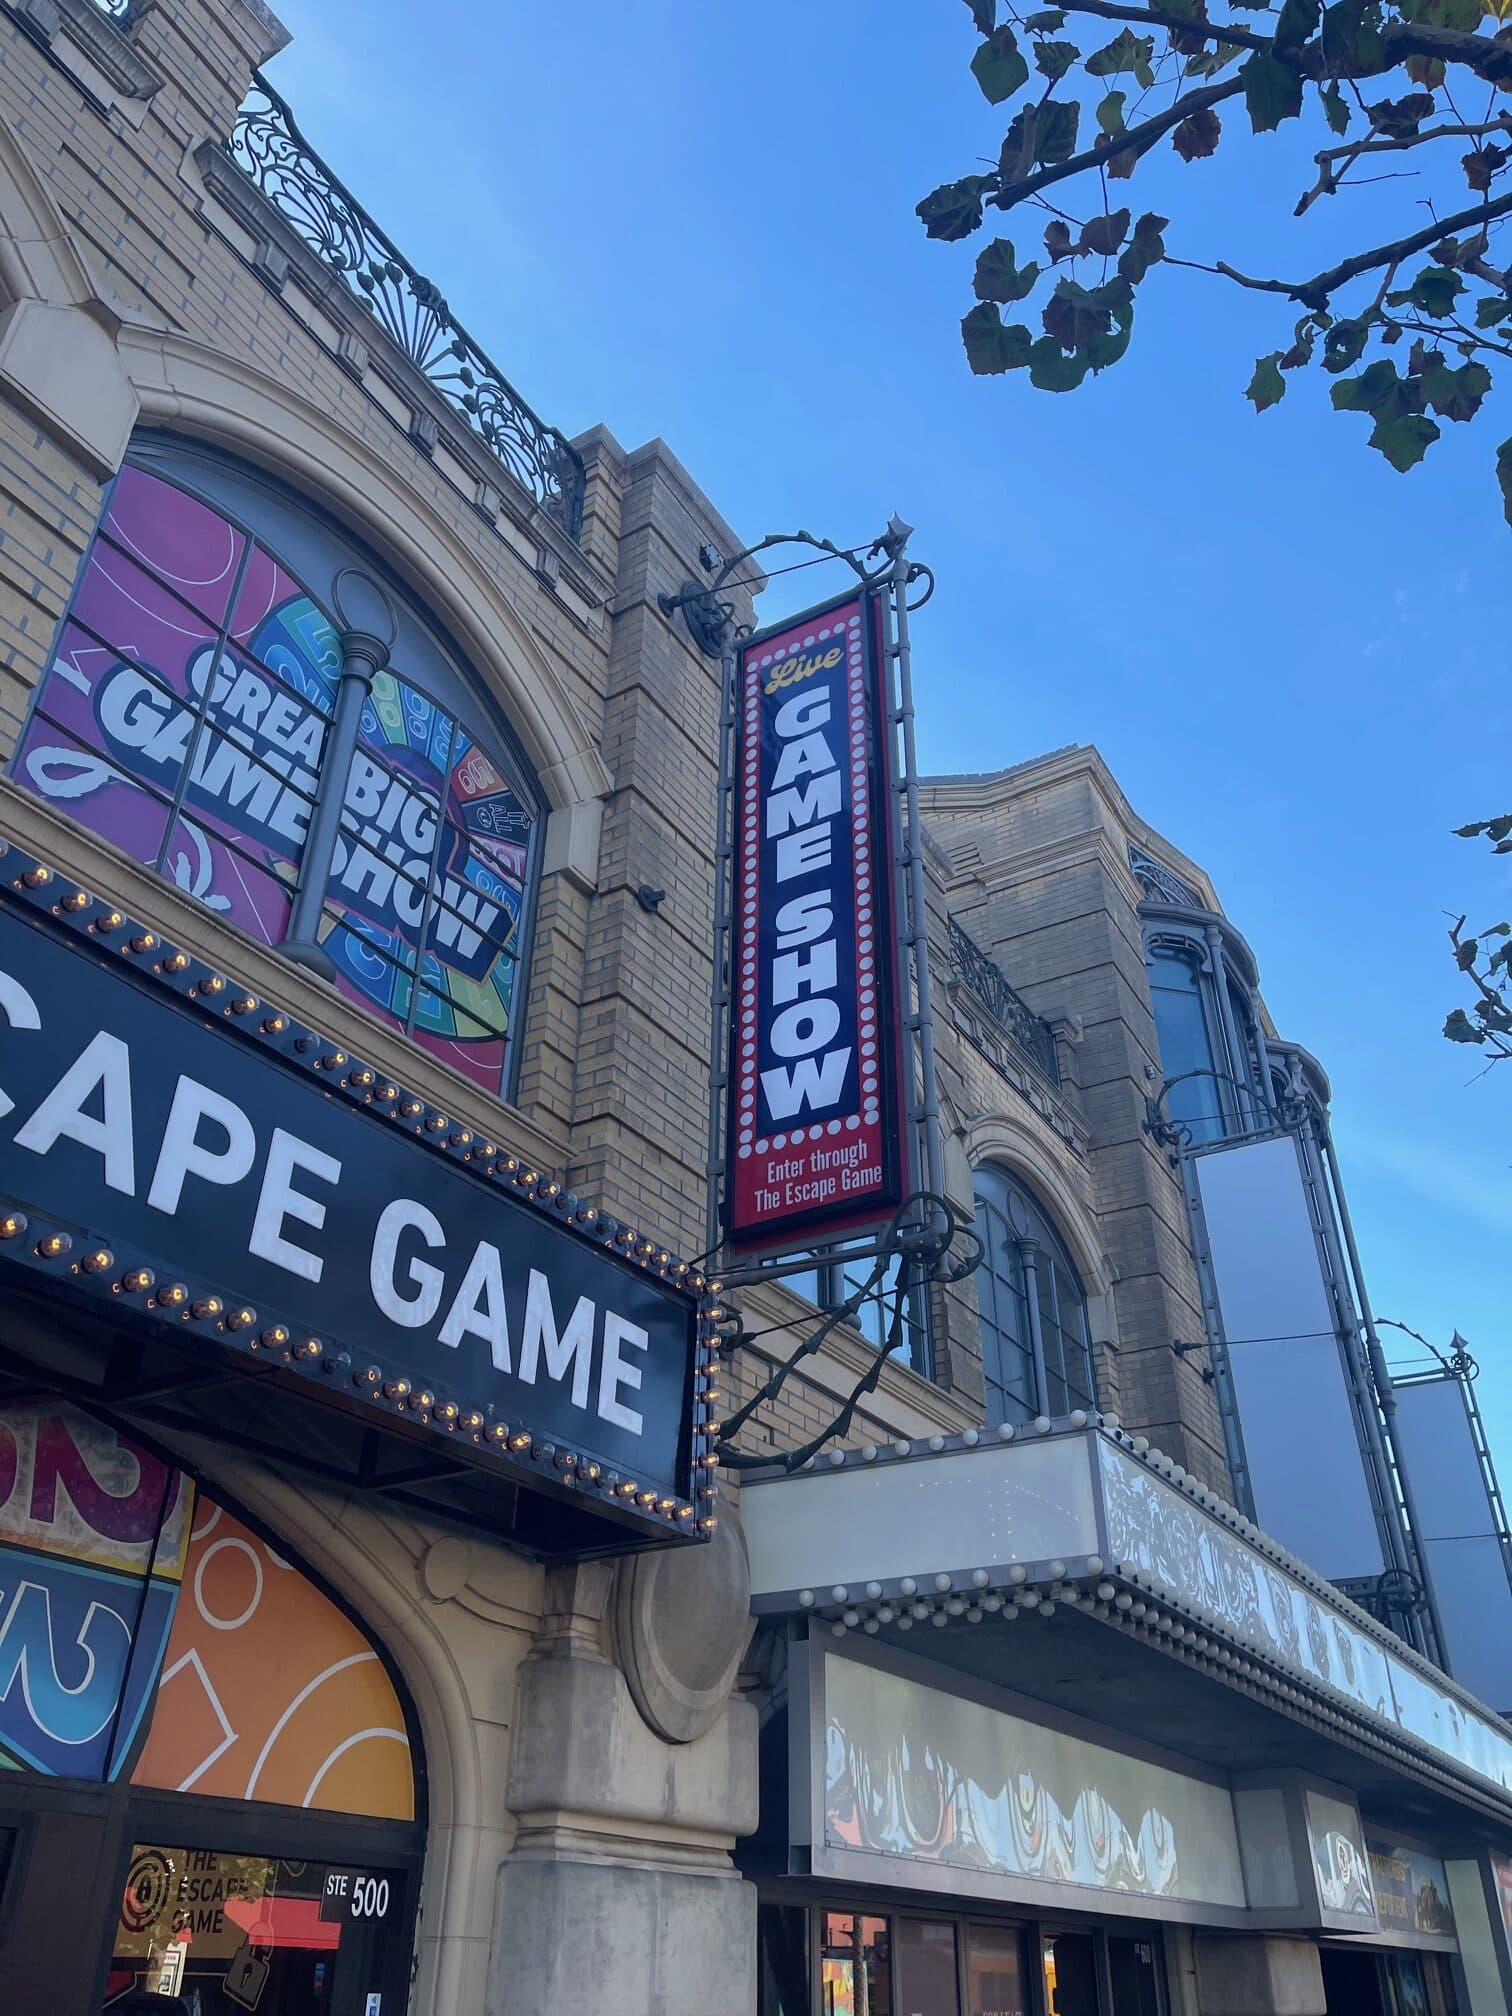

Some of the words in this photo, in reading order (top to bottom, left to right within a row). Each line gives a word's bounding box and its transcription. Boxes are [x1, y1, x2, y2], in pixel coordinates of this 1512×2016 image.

[764, 647, 845, 695] Live
[100, 667, 323, 846] GAME
[191, 649, 329, 770] GREA
[344, 749, 441, 854] BIG
[766, 685, 842, 883] GAME
[759, 888, 852, 1121] SHOW
[767, 1158, 805, 1184] Enter
[810, 1138, 868, 1172] through
[754, 1189, 780, 1213] The
[785, 1177, 836, 1202] Escape
[841, 1165, 883, 1191] Game
[369, 1199, 649, 1436] GAME
[184, 1850, 217, 1872] THE
[326, 1874, 349, 1896] STE
[351, 1876, 390, 1918] 500
[171, 1909, 224, 1934] GAME
